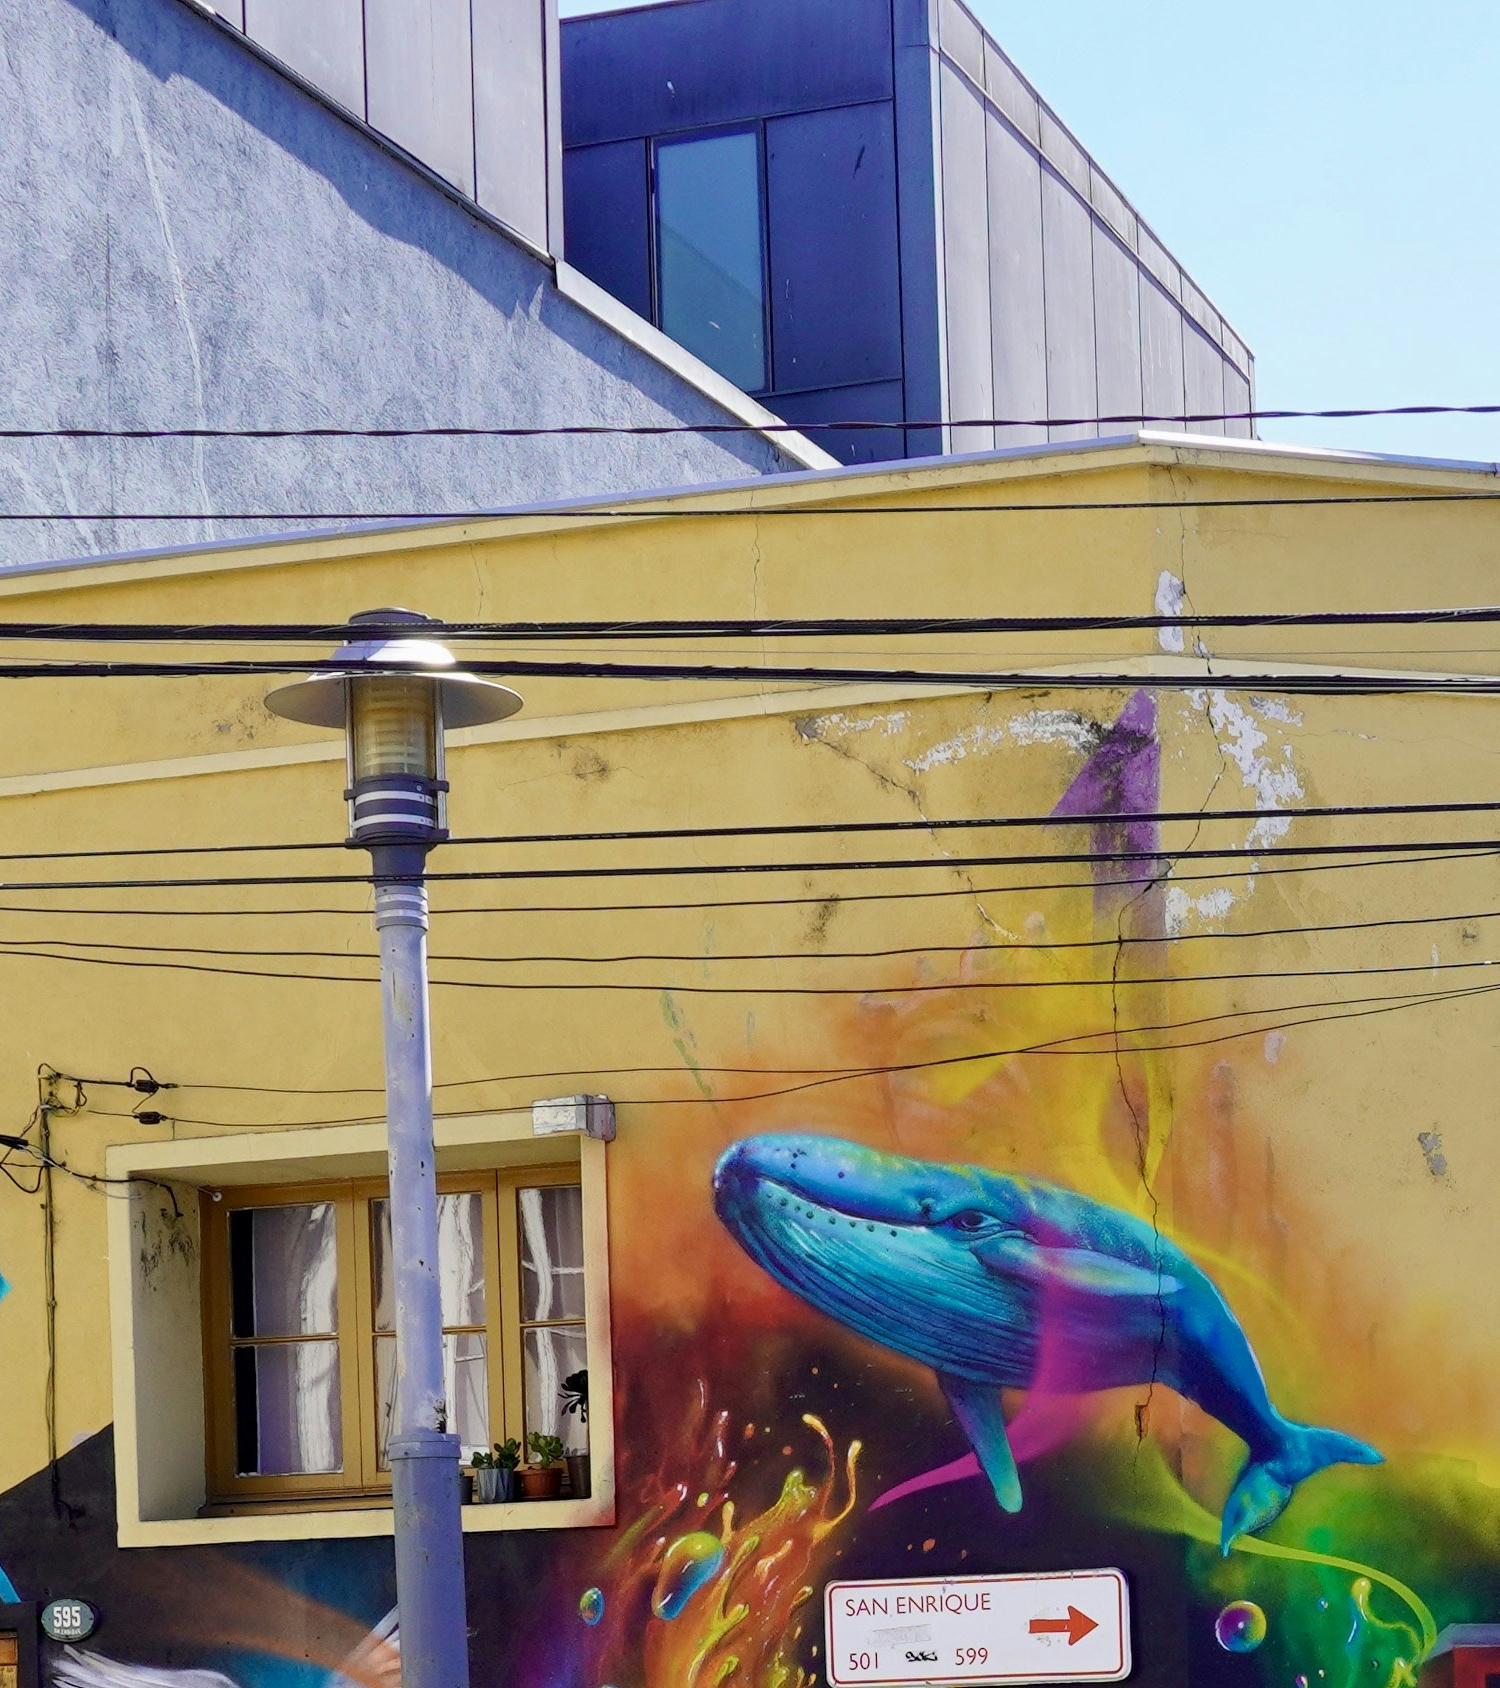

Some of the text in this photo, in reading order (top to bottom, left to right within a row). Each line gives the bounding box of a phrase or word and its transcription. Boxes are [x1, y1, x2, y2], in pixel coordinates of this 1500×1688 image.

[845, 1592, 991, 1616] SAN ENRIQUE
[53, 1606, 81, 1628] 595
[849, 1652, 879, 1670] 501
[955, 1647, 988, 1666] 599
